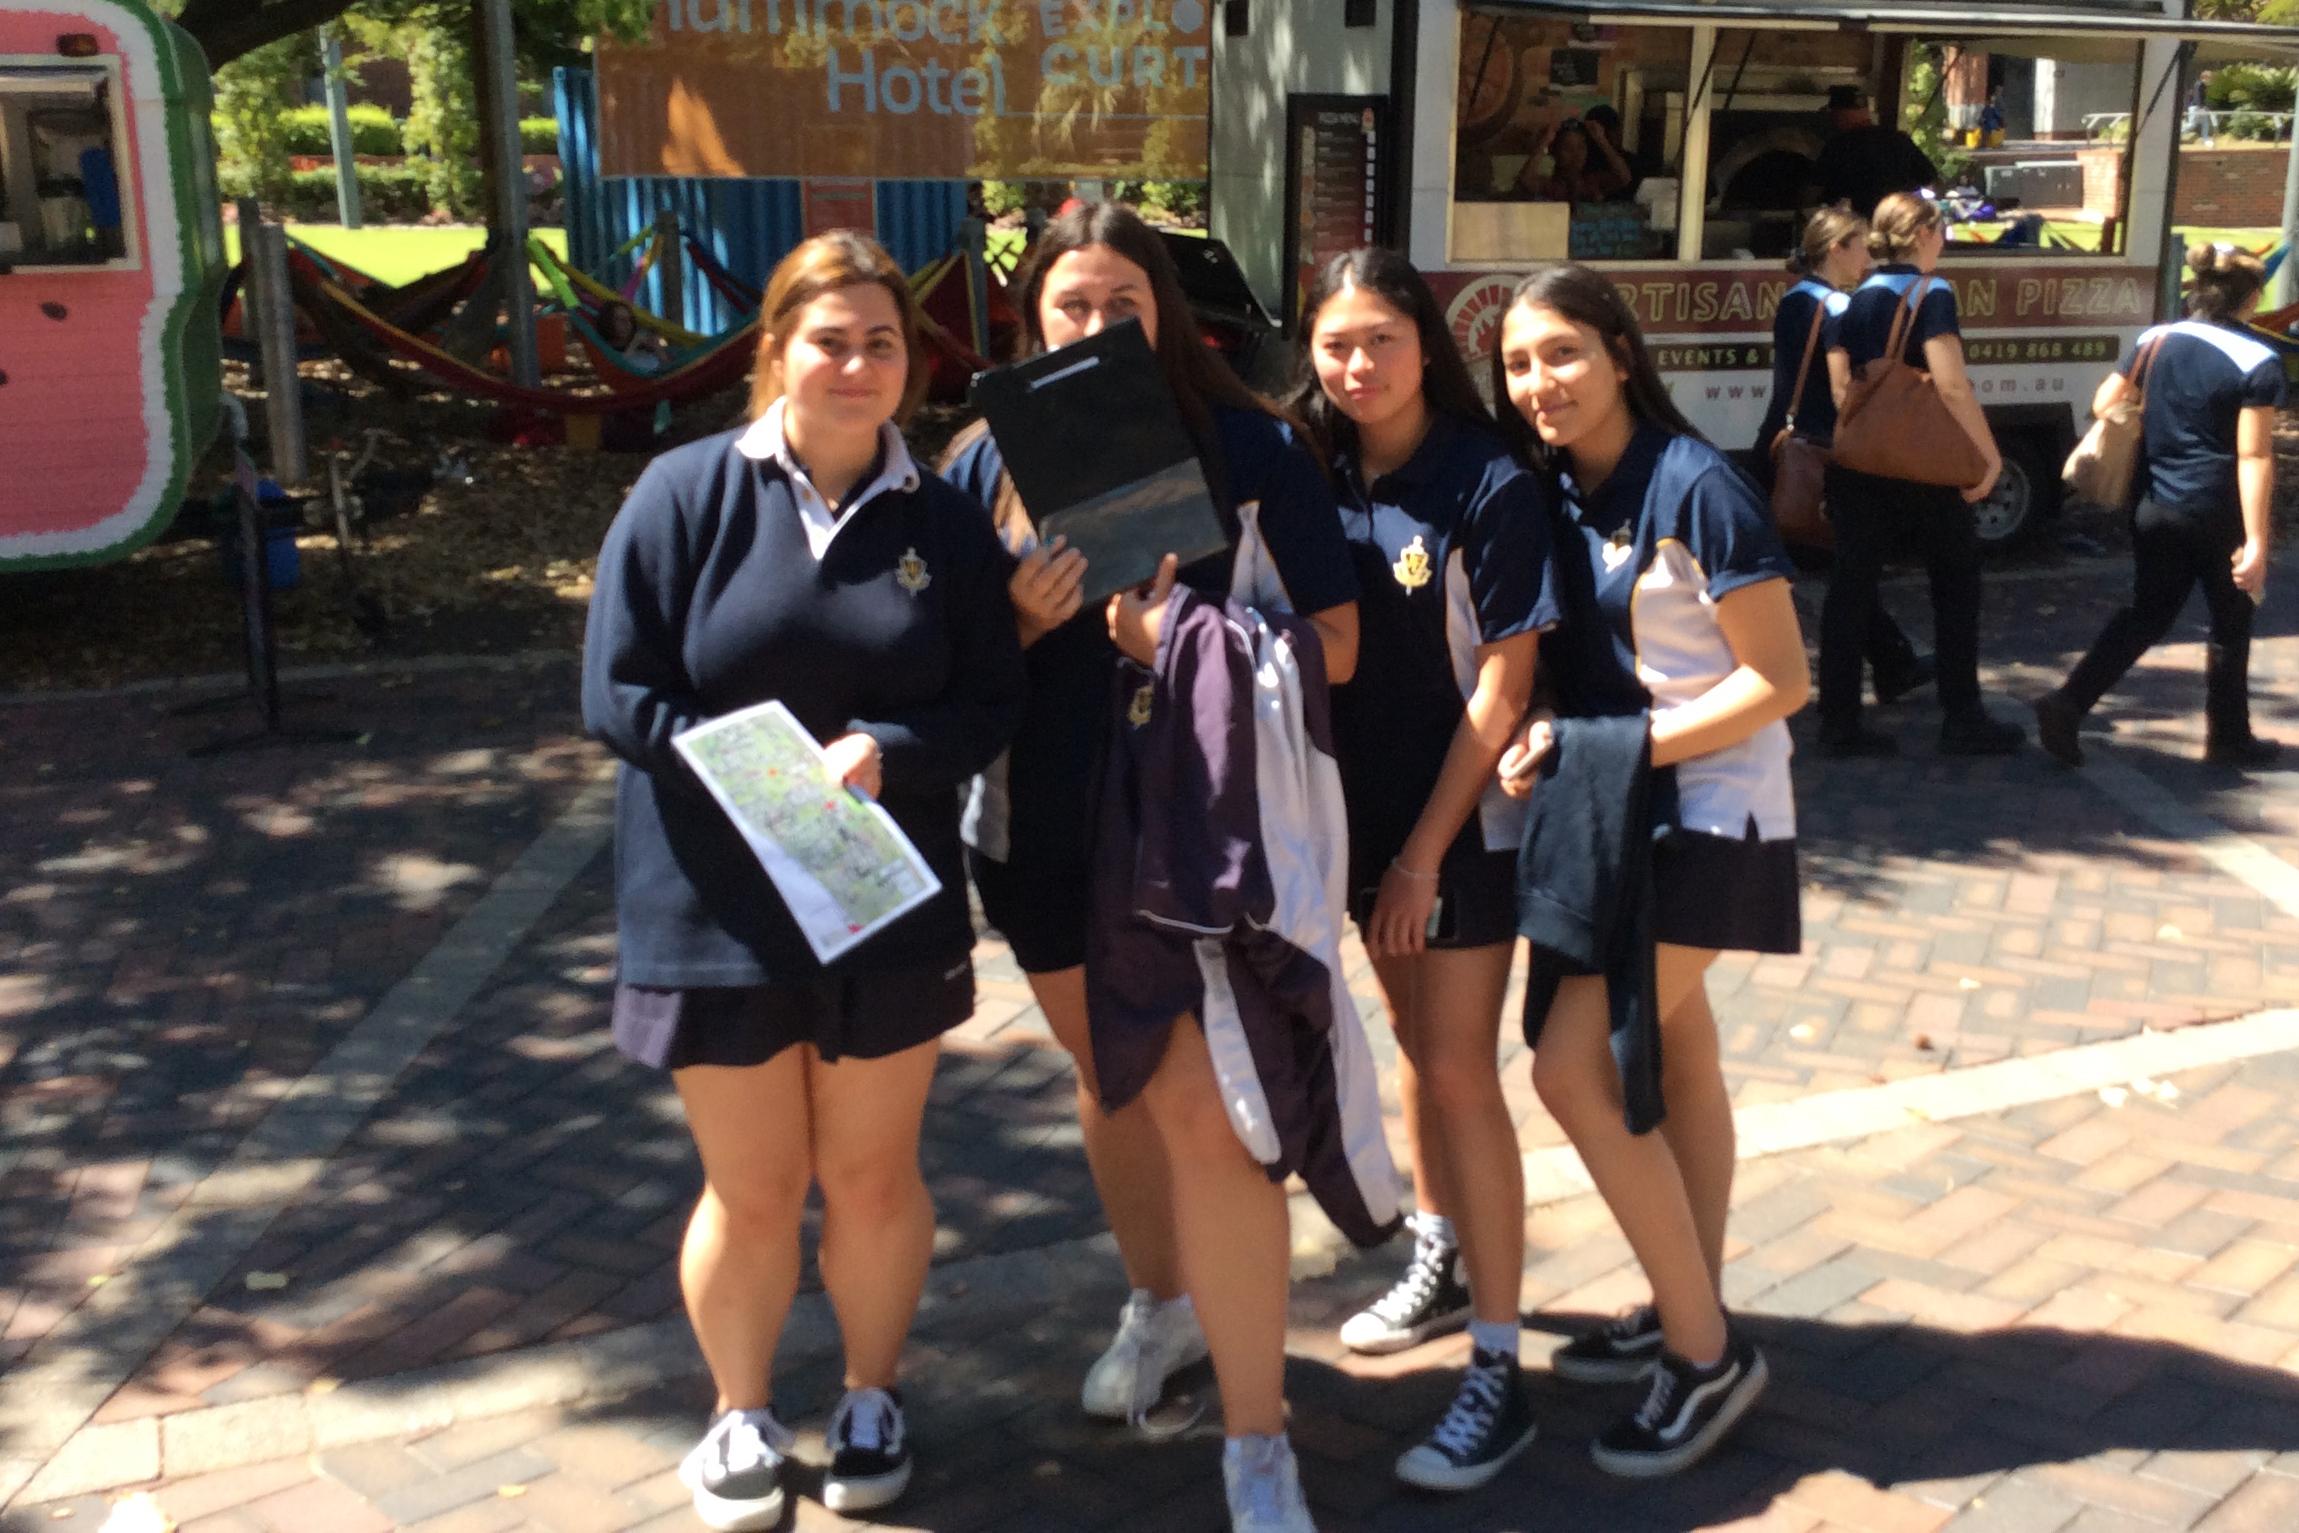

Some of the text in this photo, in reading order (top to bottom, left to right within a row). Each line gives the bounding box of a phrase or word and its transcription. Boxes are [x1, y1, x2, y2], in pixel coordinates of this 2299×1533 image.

[828, 48, 1005, 116] Hotel
[1614, 282, 1787, 321] RTISAN
[2016, 277, 2141, 316] PIZZA
[1657, 349, 1737, 366] EVENTS
[1745, 349, 1759, 365] &
